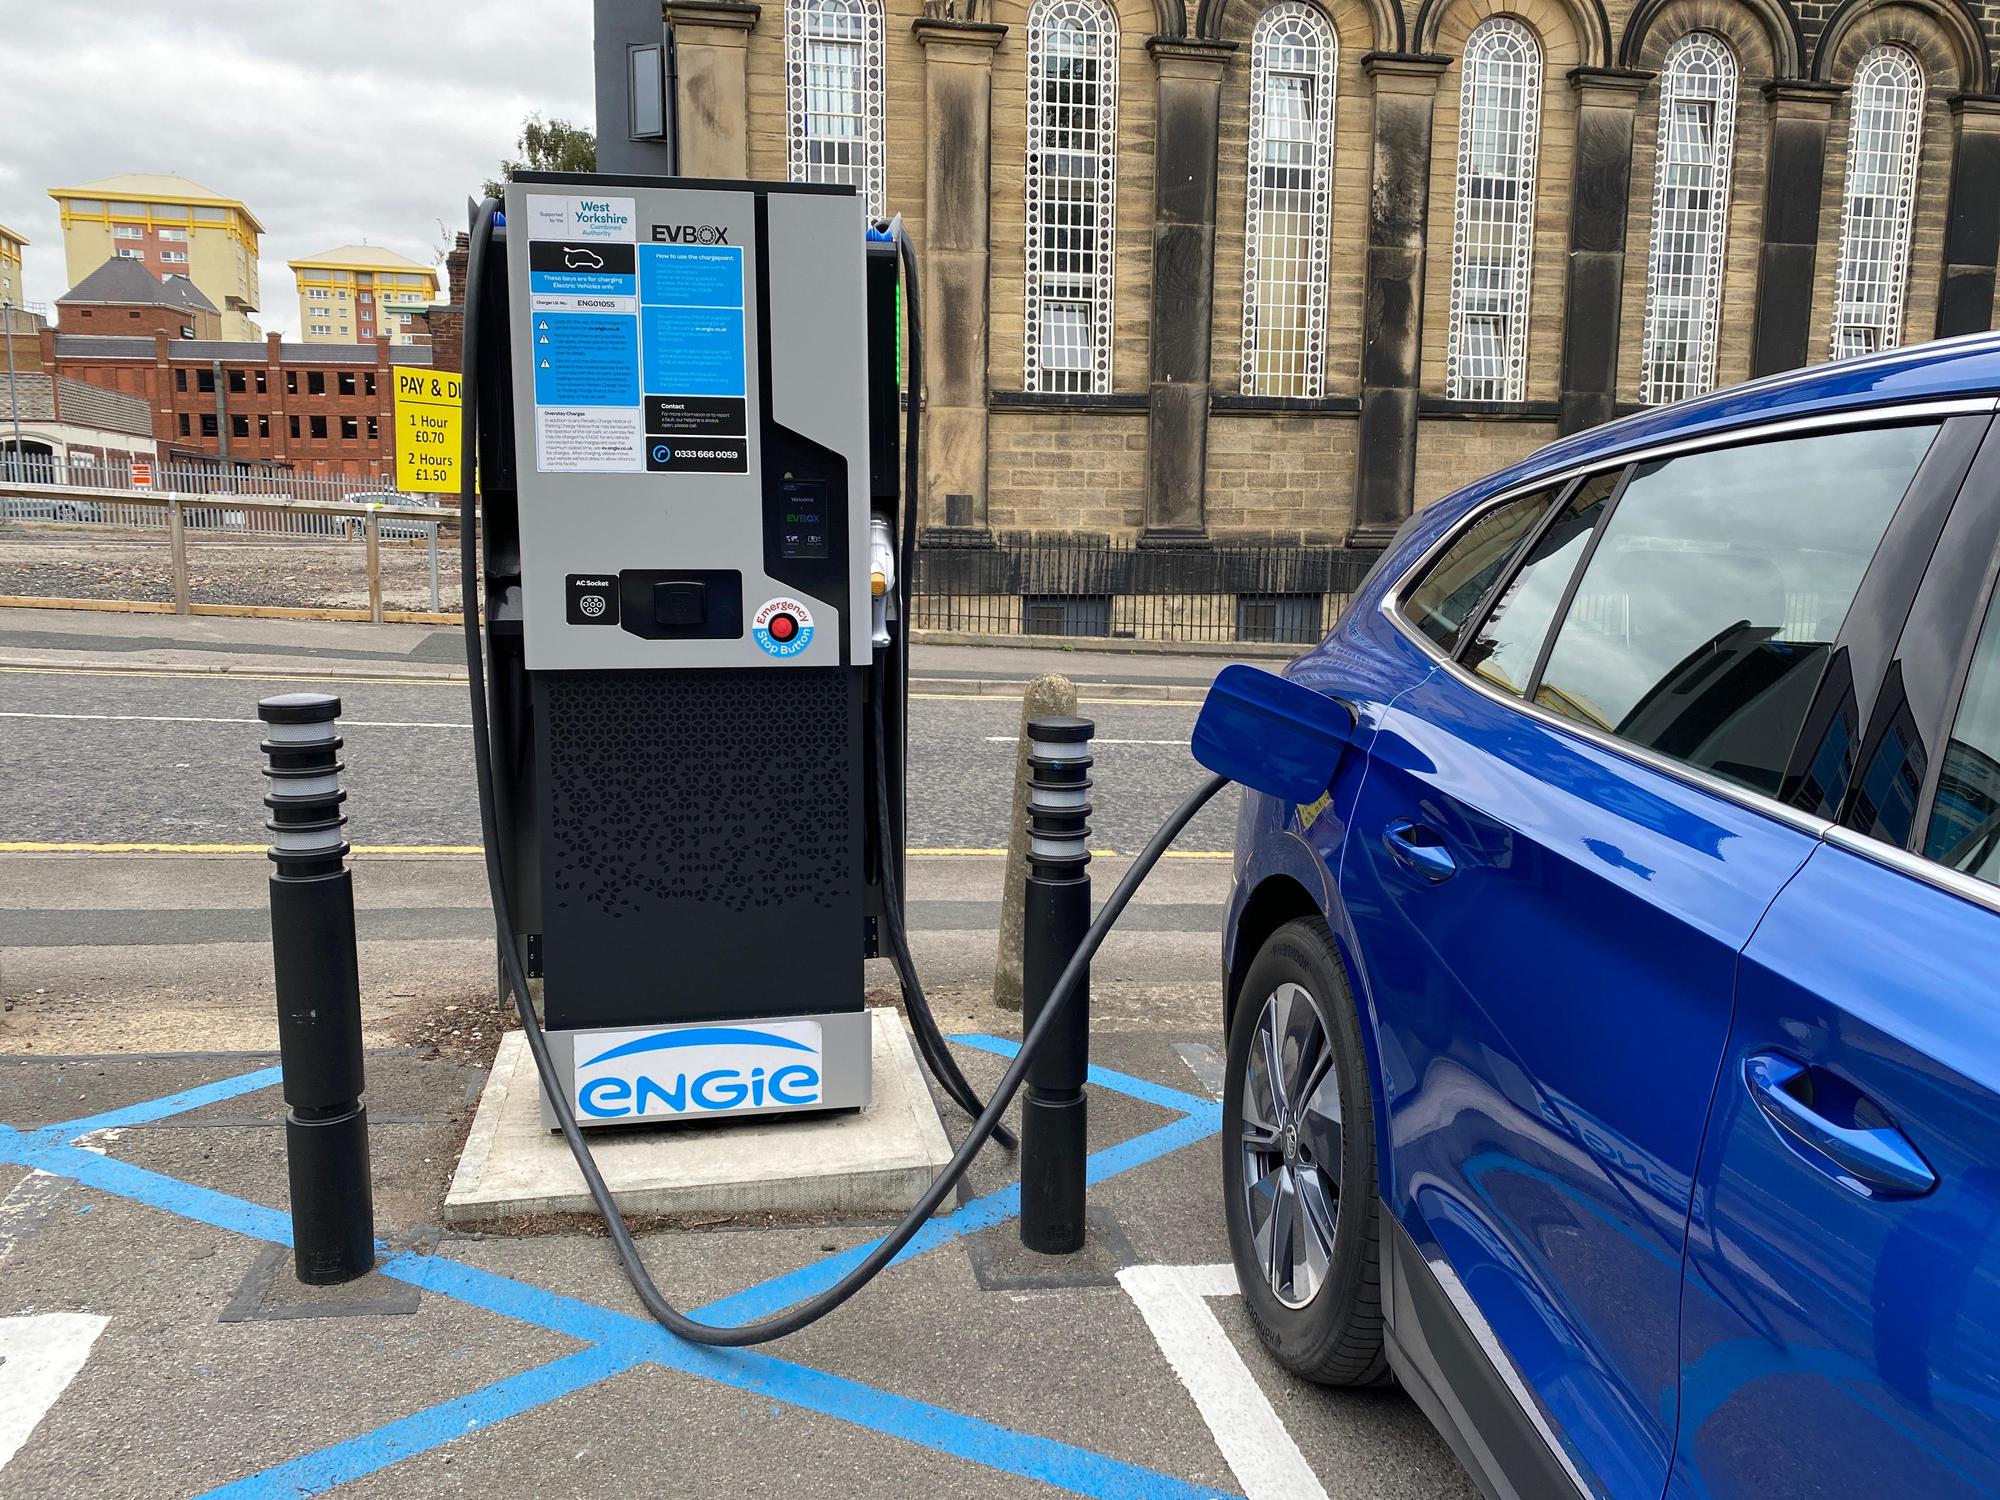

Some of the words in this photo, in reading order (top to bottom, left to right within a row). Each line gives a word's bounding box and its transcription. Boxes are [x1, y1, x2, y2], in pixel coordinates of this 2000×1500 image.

[581, 201, 610, 212] West
[575, 211, 628, 224] Yorkshire
[651, 224, 728, 245] EVBOX
[577, 300, 616, 308] ENG01055
[400, 376, 424, 395] PAY
[431, 378, 442, 397] &
[410, 414, 417, 426] 1
[421, 415, 448, 428] Hour
[415, 430, 445, 444] £0.70
[408, 452, 415, 464] 2
[420, 453, 453, 466] Hours
[674, 450, 697, 458] 0333
[697, 450, 715, 458] 666
[715, 451, 738, 459] 0059
[416, 469, 447, 481] £1.50
[786, 514, 820, 522] EVBOX
[756, 600, 809, 625] Emergency
[758, 630, 778, 654] Stop
[780, 628, 811, 655] Button
